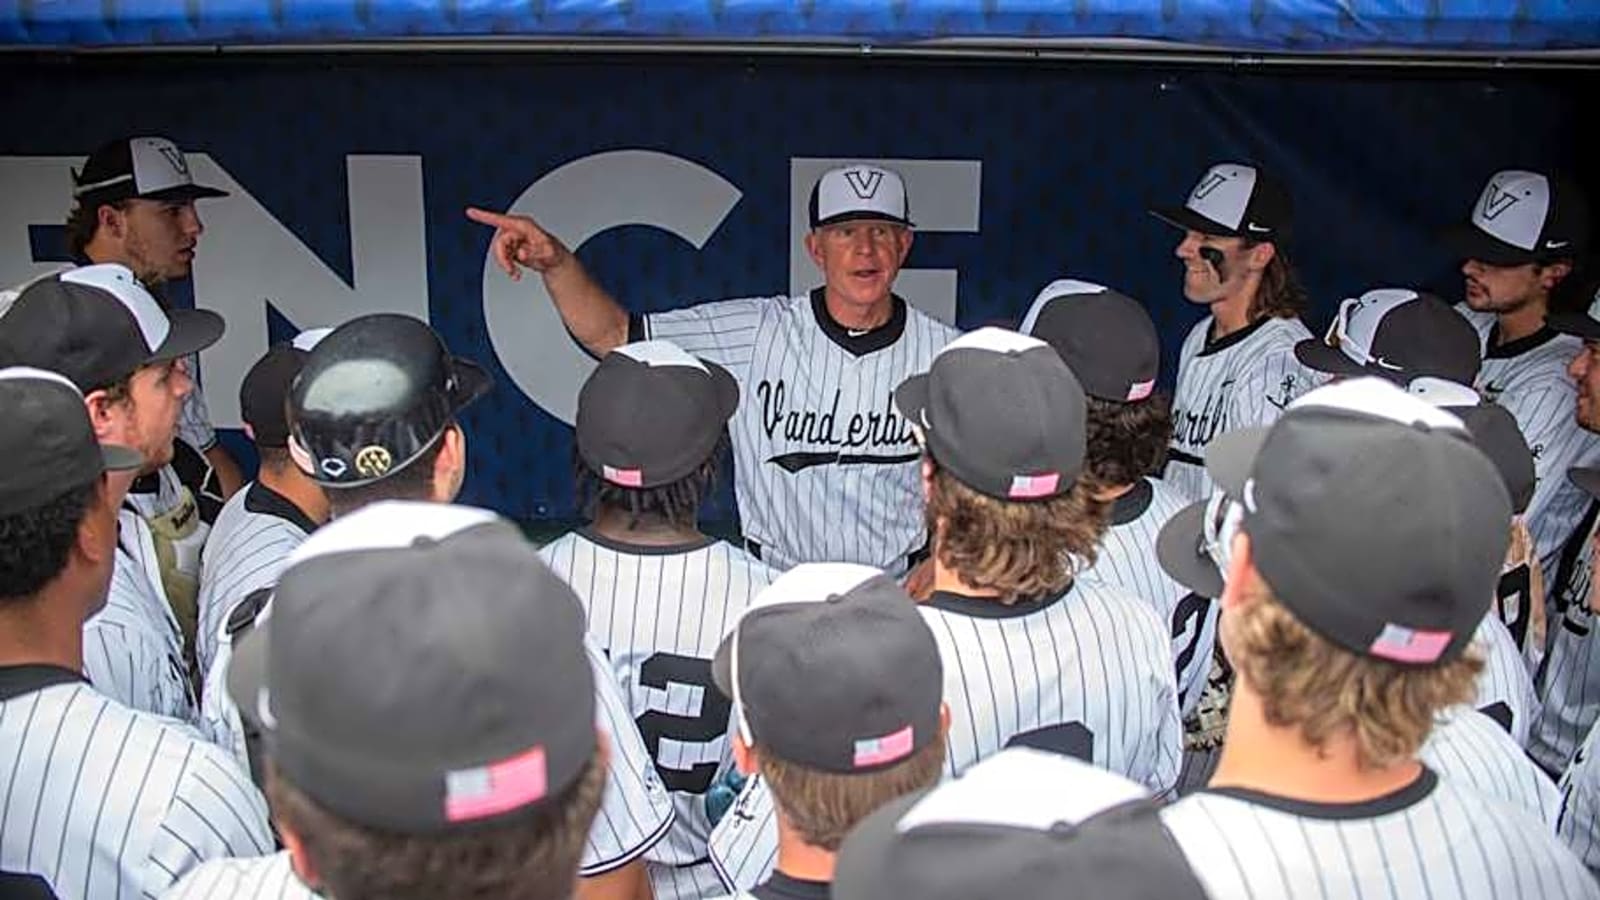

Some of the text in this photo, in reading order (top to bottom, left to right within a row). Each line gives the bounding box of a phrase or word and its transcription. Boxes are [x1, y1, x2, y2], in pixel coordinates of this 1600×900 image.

[844, 170, 885, 200] V
[1482, 182, 1520, 221] V
[634, 651, 734, 794] 2
